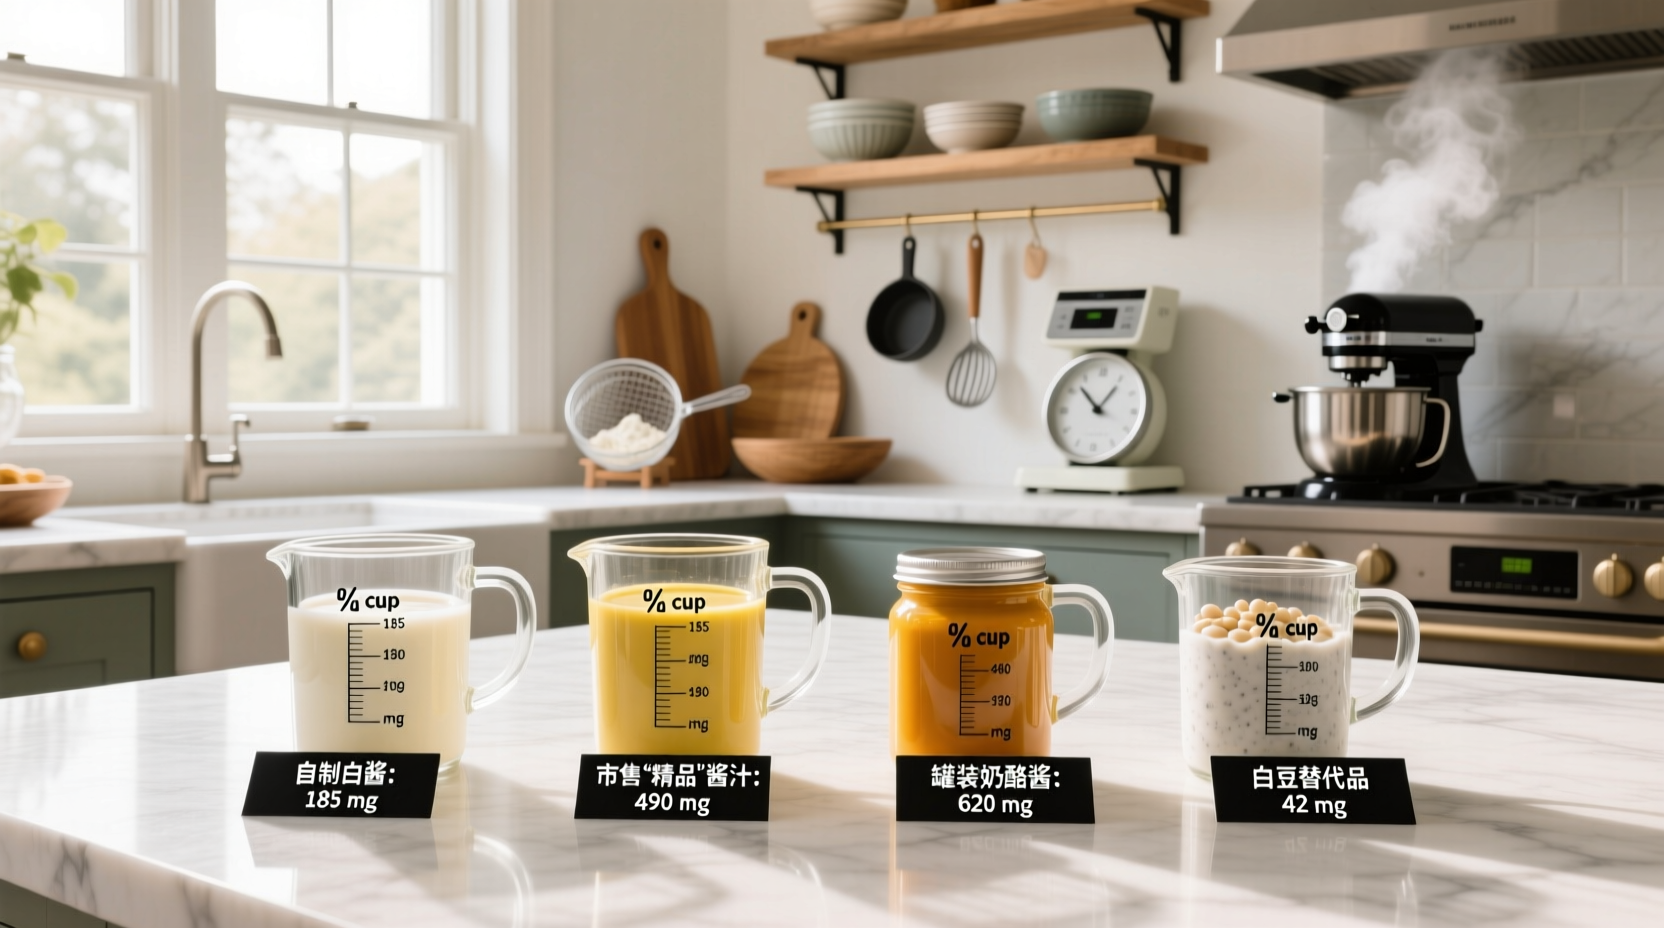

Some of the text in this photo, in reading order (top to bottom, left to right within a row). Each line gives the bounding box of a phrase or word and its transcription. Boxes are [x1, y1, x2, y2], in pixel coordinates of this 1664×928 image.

[365, 595, 400, 612] cup
[672, 596, 706, 613] cup
[977, 631, 1010, 649] cup
[1285, 622, 1318, 641] cup
[383, 714, 405, 728] mg
[688, 719, 709, 733] mg
[991, 728, 1011, 741] mg
[1298, 727, 1318, 740] mg
[1253, 765, 1369, 790] 白豆替代品
[305, 789, 379, 814] 185 mg
[634, 792, 711, 817] 490 mg
[958, 794, 1033, 818] 620 mg
[1282, 794, 1347, 819] 42 mg
